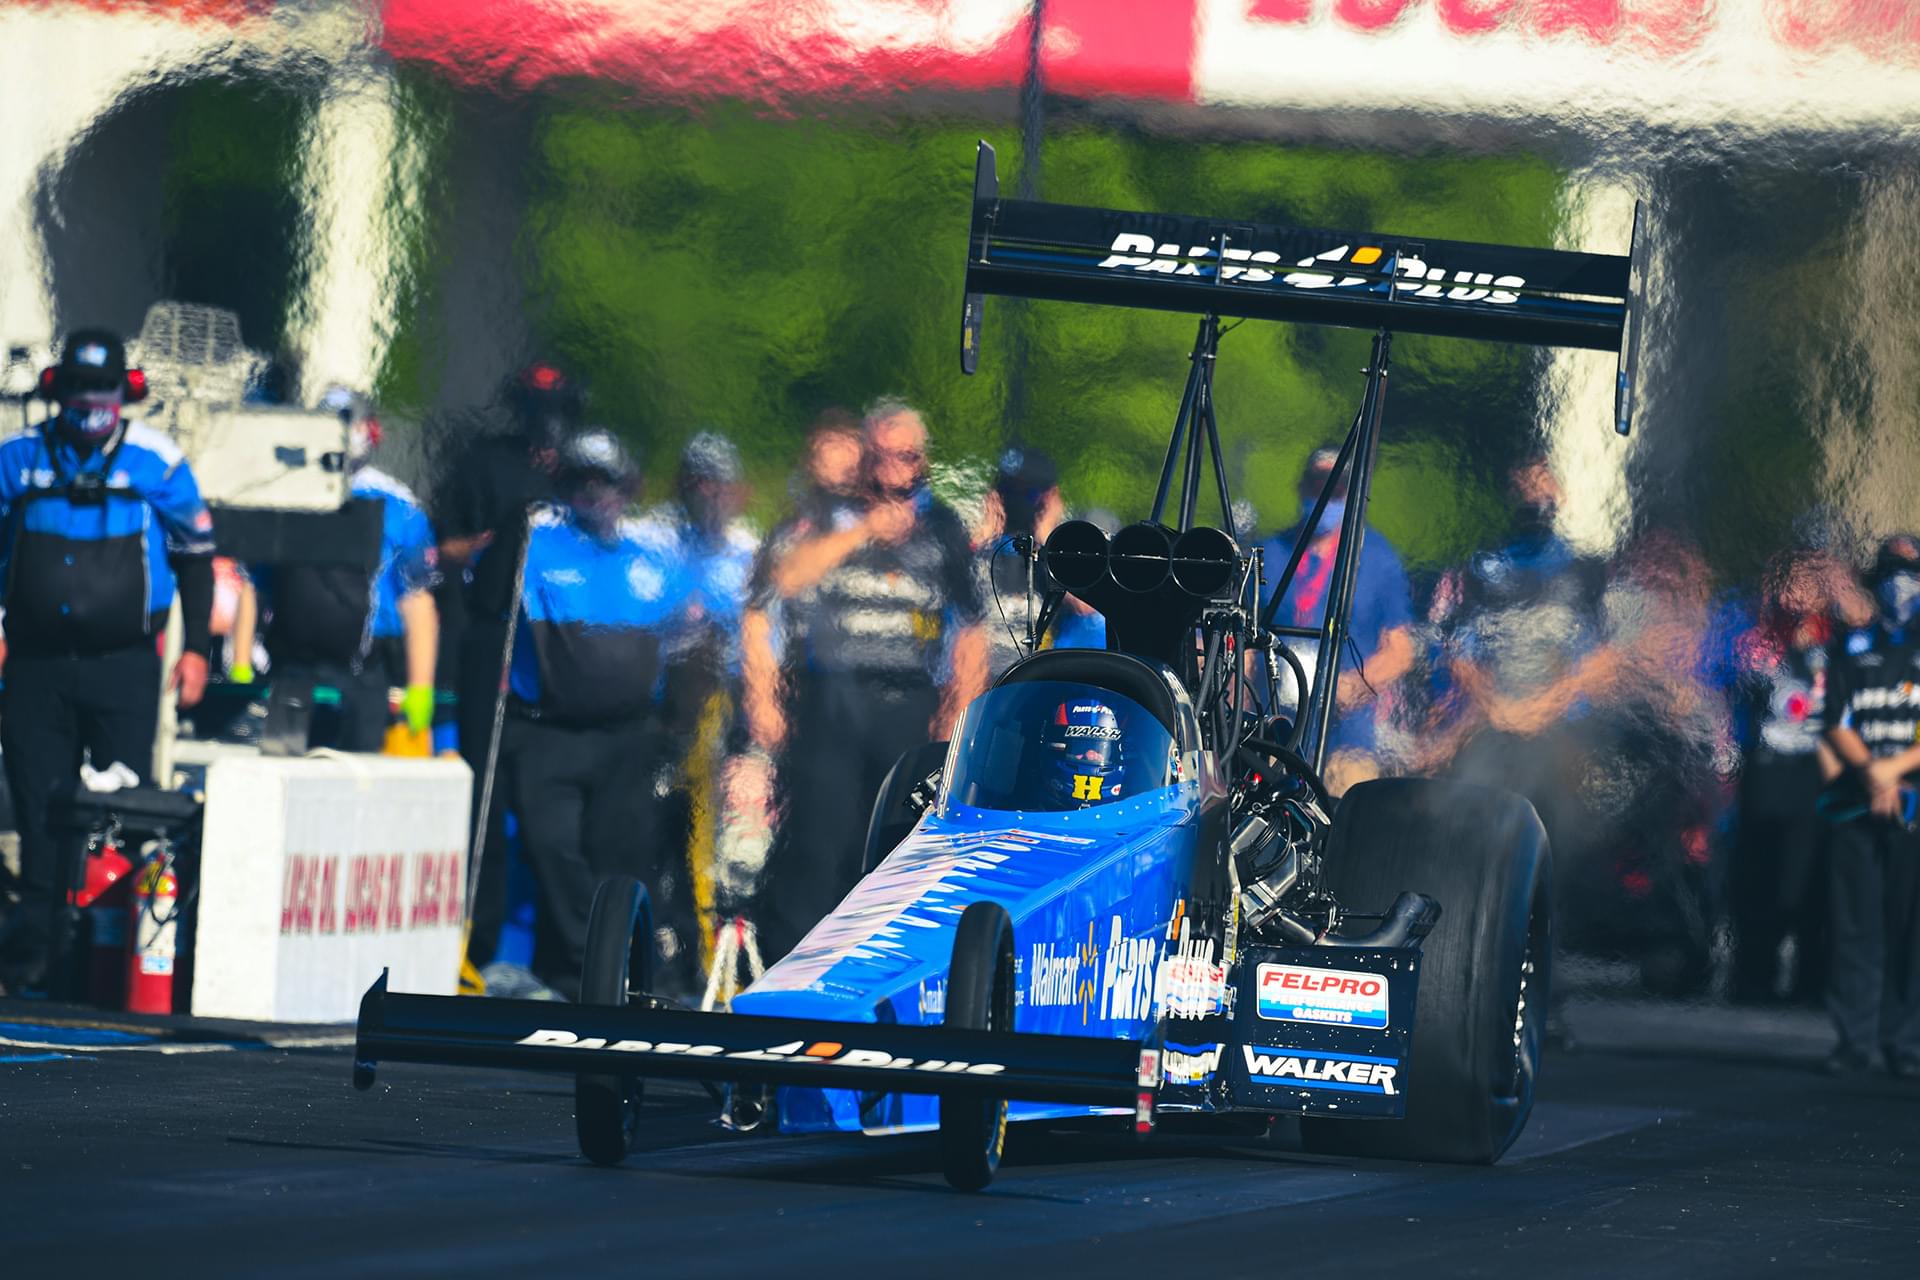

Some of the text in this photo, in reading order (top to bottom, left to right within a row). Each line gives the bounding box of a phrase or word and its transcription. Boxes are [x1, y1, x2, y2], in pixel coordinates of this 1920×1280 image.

[1097, 232, 1281, 282] PARTS
[1370, 256, 1526, 304] PLUS
[1065, 725, 1122, 741] WALSH
[1030, 942, 1080, 1006] Walmart
[1262, 971, 1381, 996] FEL-PRO
[1292, 1007, 1353, 1023] GASKETS
[1243, 1044, 1396, 1095] WALKER
